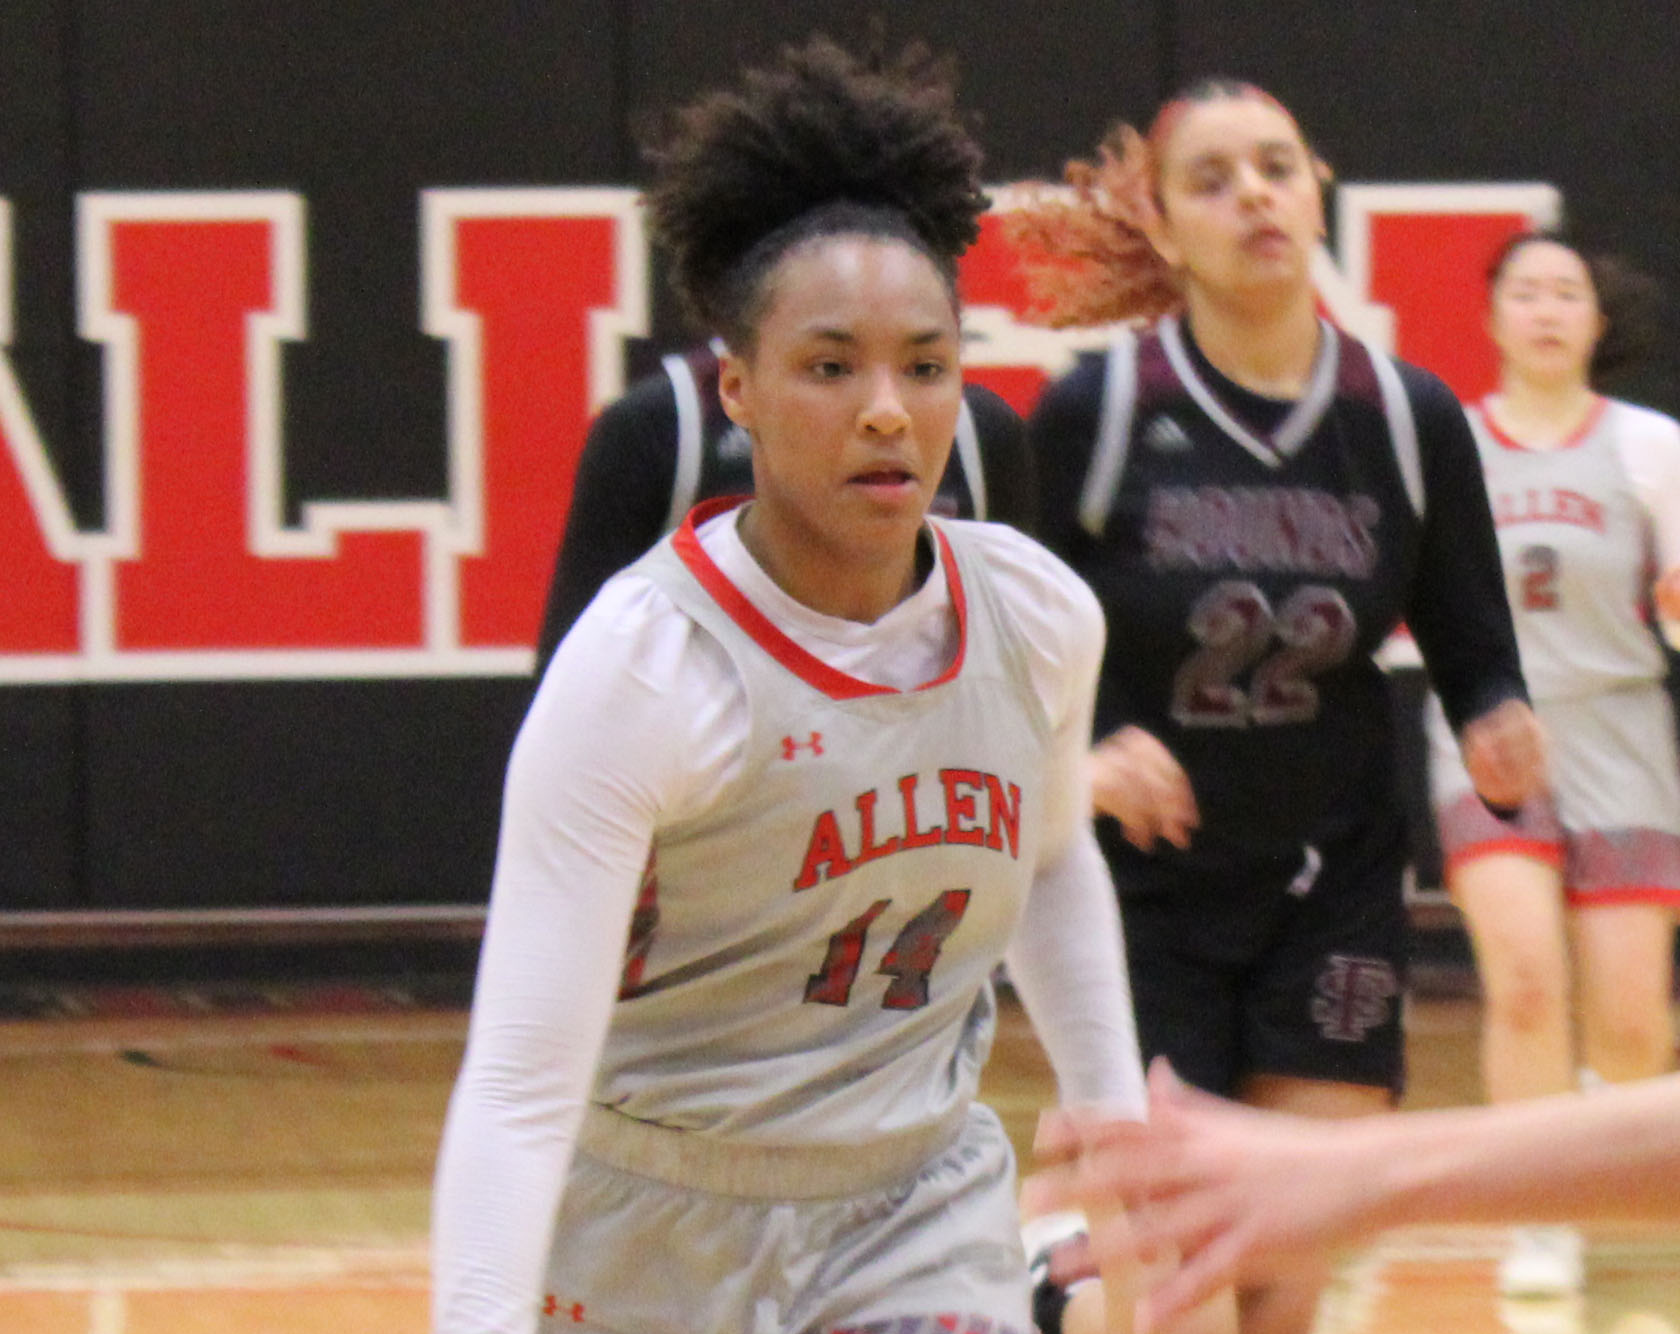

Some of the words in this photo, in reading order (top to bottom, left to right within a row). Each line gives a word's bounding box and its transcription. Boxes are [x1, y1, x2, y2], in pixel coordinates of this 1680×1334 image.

[1492, 486, 1609, 535] LLEN
[1519, 544, 1561, 613] 2
[1171, 580, 1358, 728] 22
[793, 767, 1023, 893] ALLEN
